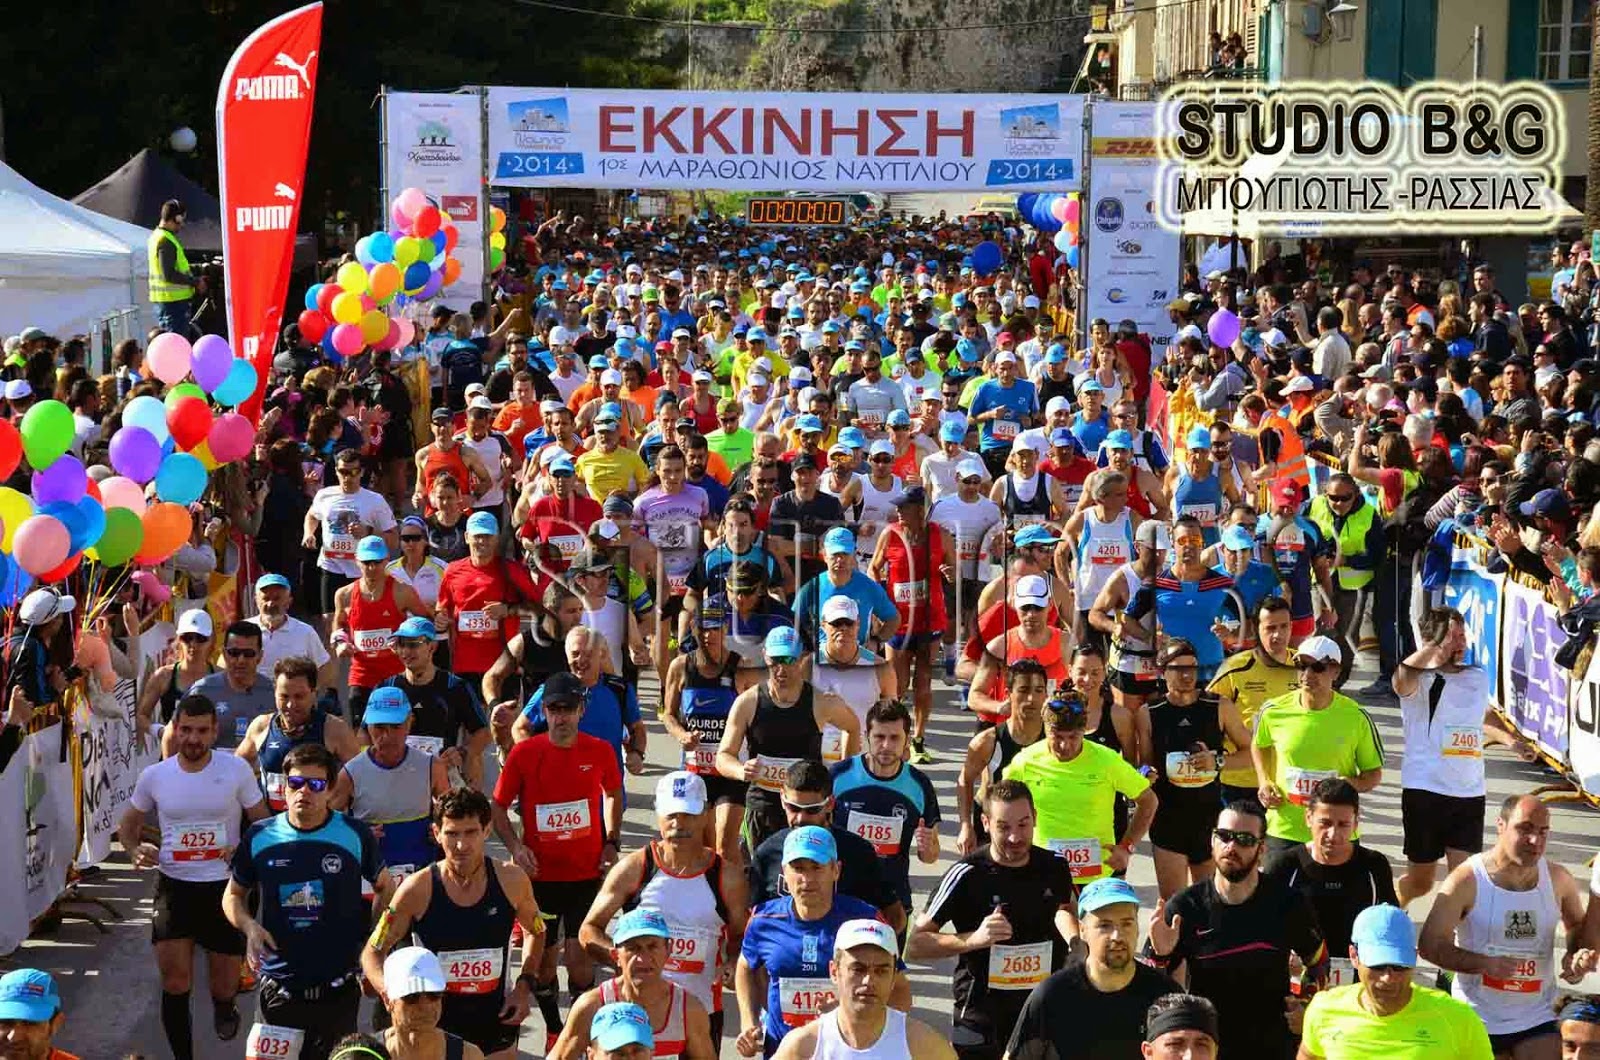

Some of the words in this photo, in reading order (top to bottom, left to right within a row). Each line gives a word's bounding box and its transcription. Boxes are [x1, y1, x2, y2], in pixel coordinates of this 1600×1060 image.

[235, 75, 299, 101] PUMA
[599, 105, 976, 158] ΕΚΚΙΝΗΣΗ
[638, 158, 827, 181] ΜΑΡΑΘΩΝΙΟΣ
[836, 161, 976, 182] ΝΑΥΠΛΙΟΥ
[751, 200, 842, 222] 00:00:00
[1098, 545, 1122, 556] 4201
[360, 635, 386, 649] 4069
[546, 811, 583, 829] 4246
[181, 831, 216, 848] 4252
[857, 823, 893, 841] 4185
[1064, 848, 1091, 864] 063
[449, 959, 493, 978] 4268
[1002, 955, 1042, 974] 2683
